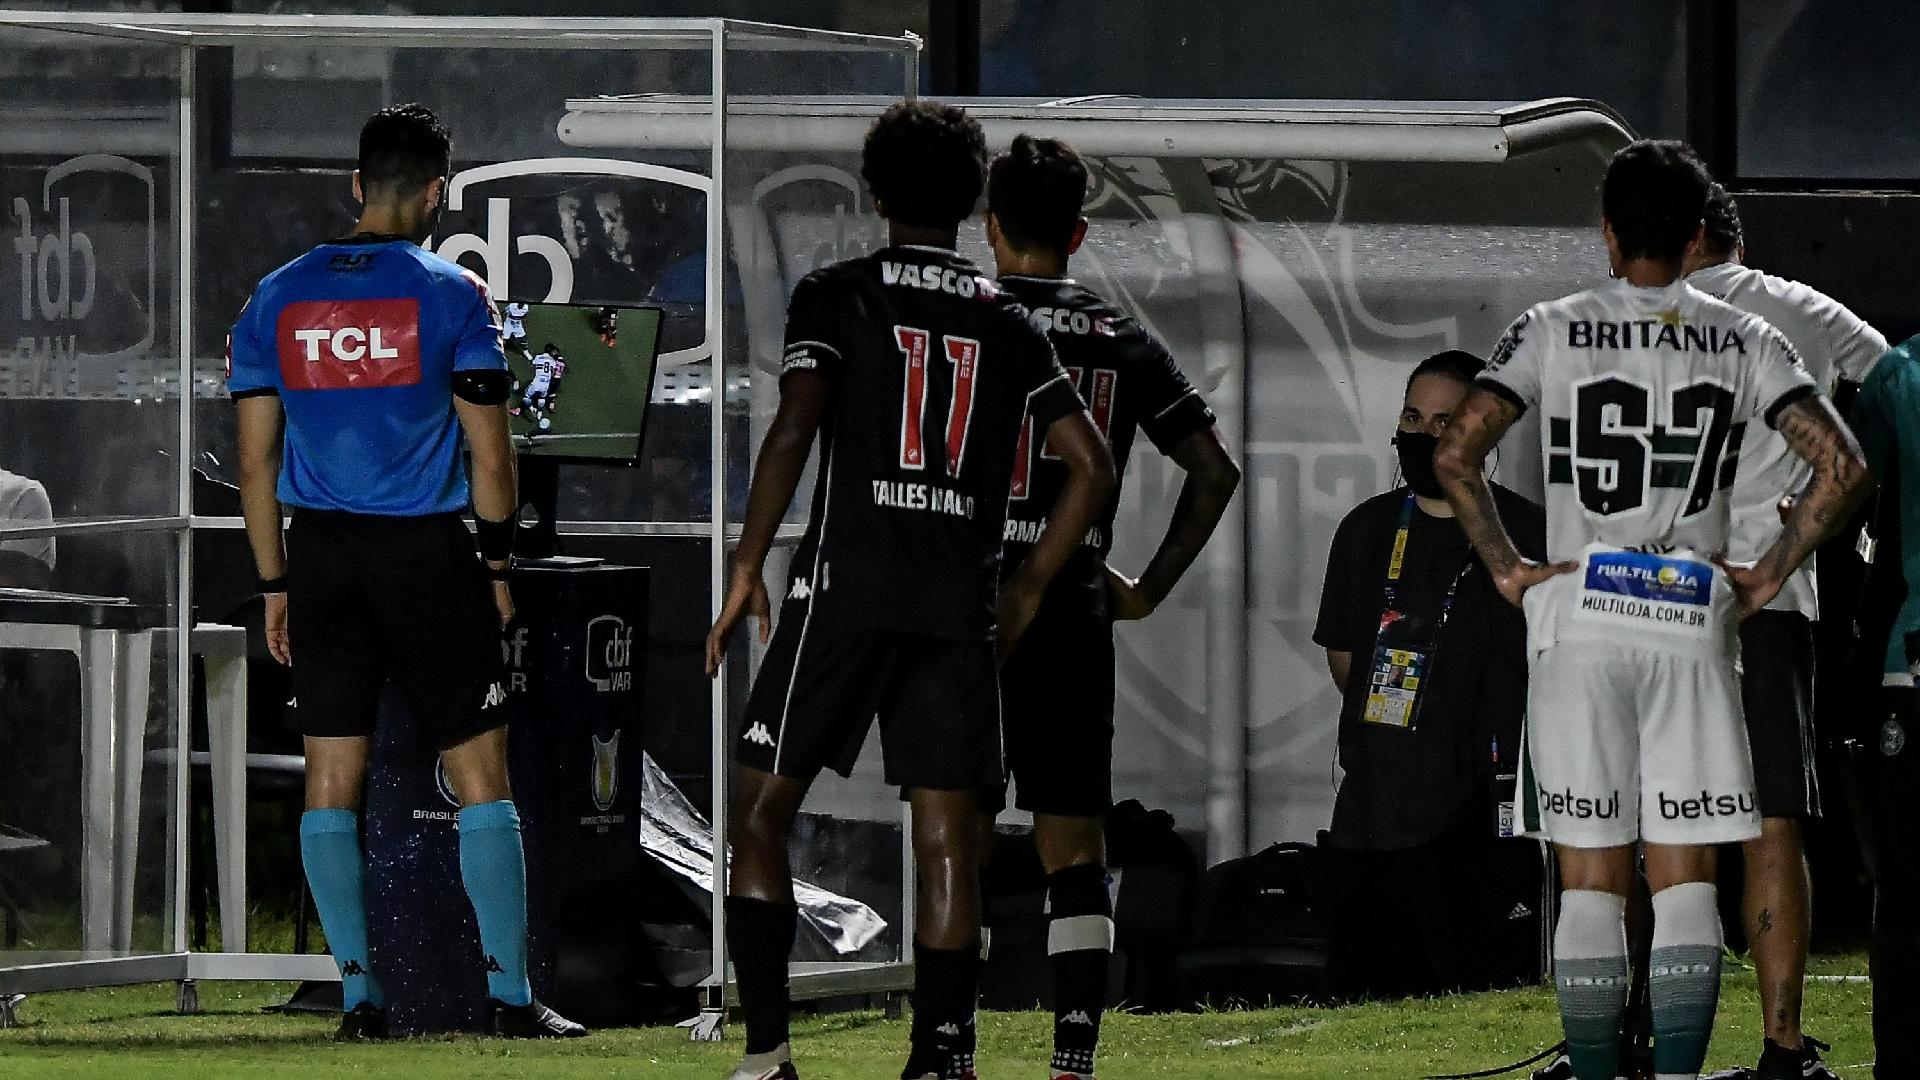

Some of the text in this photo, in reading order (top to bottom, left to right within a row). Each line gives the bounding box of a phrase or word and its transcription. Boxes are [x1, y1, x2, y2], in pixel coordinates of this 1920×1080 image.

[881, 261, 976, 299] VASCO
[295, 327, 399, 362] TCL
[1568, 320, 1746, 354] BRITANIA
[893, 323, 981, 480] 11
[872, 479, 929, 510] TALLES
[1582, 596, 1706, 627] MULTILOJA.COM.BR
[604, 626, 633, 669] cbf
[609, 672, 632, 693] VAR
[412, 808, 460, 822] BRASILE
[1659, 788, 1755, 820] betsu
